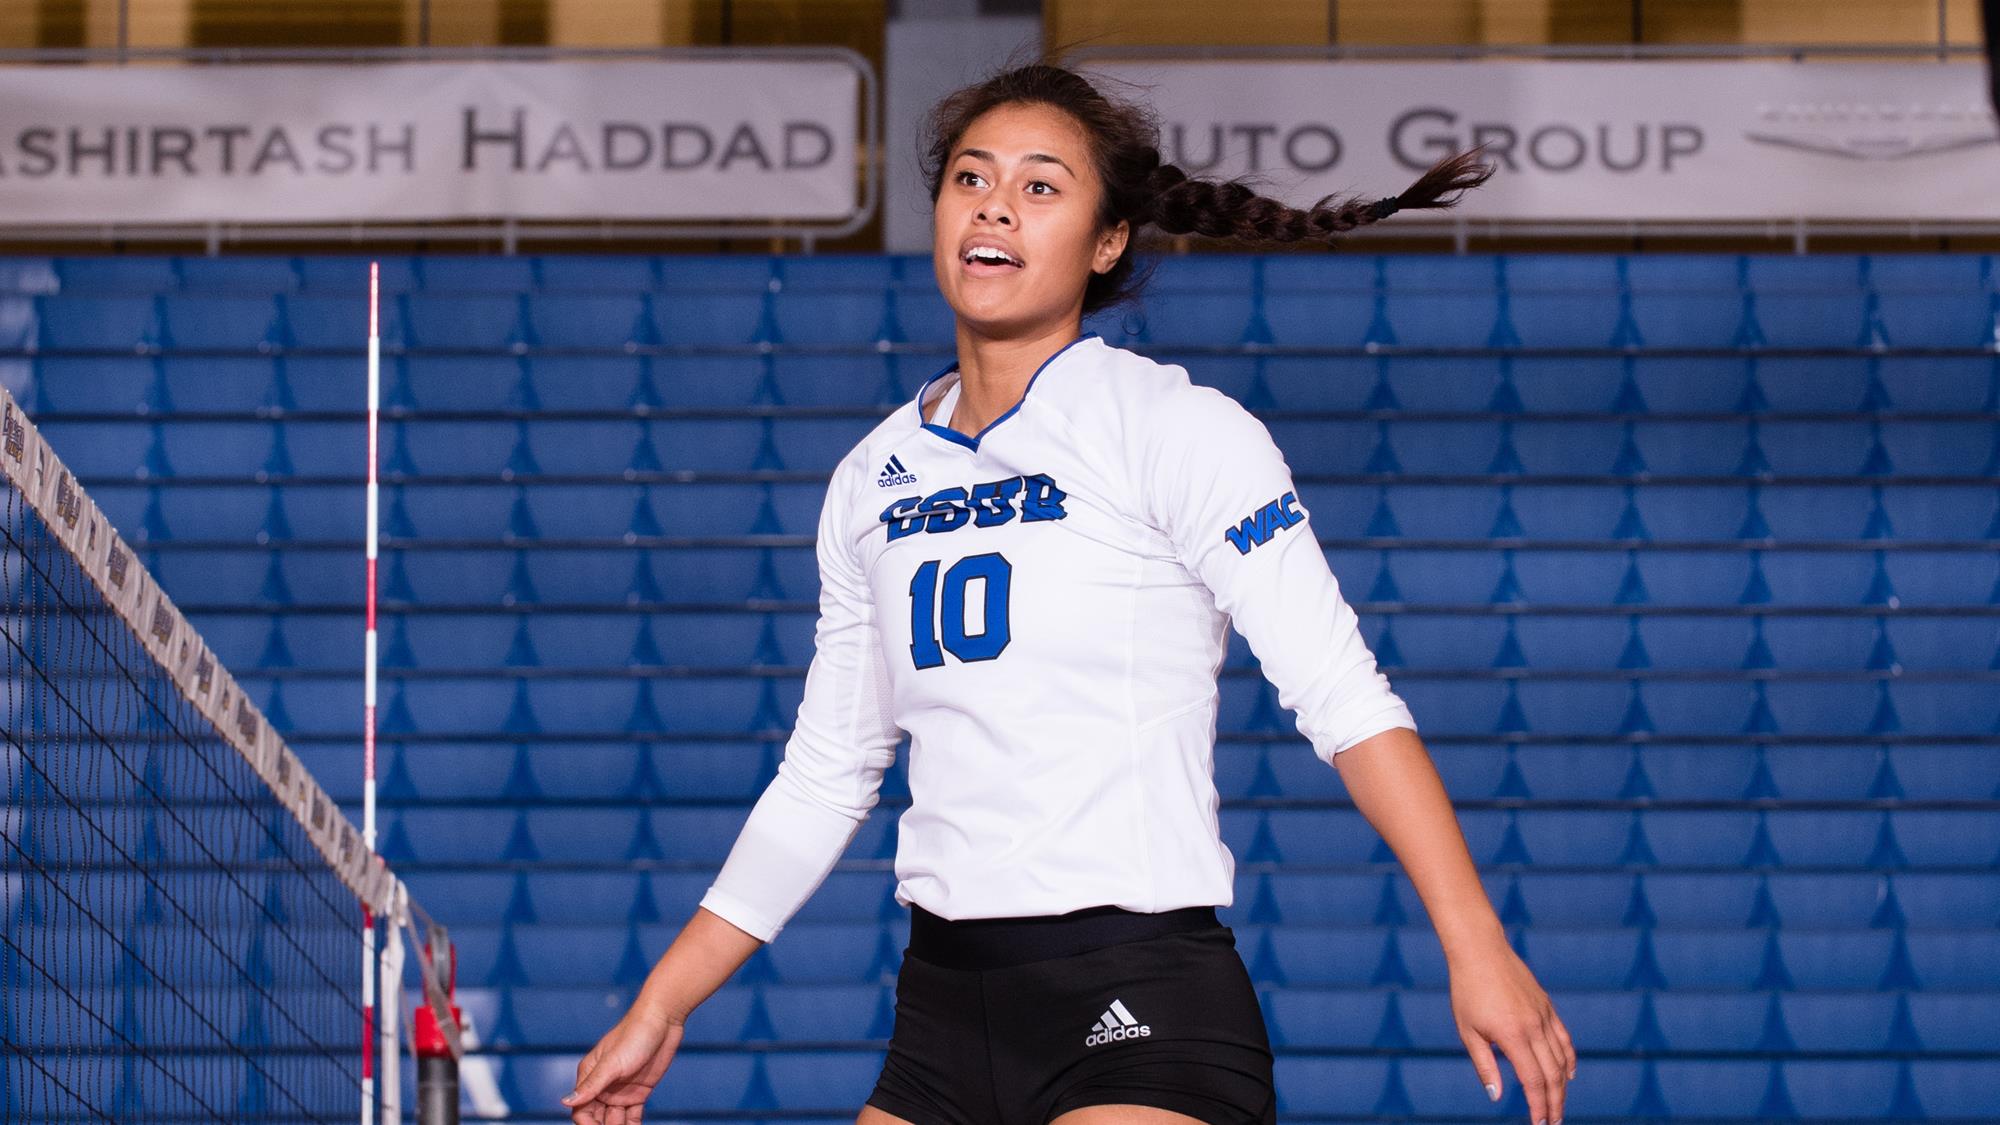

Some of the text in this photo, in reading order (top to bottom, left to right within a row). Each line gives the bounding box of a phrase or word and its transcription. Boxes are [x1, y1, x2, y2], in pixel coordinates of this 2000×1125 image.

[0, 106, 834, 177] SHIRTASH HADDAD
[1170, 105, 1705, 174] UTO GROUP
[878, 472, 917, 488] adidas
[1225, 491, 1305, 556] WAC
[909, 551, 1012, 671] 10
[1085, 1024, 1151, 1047] adidas
